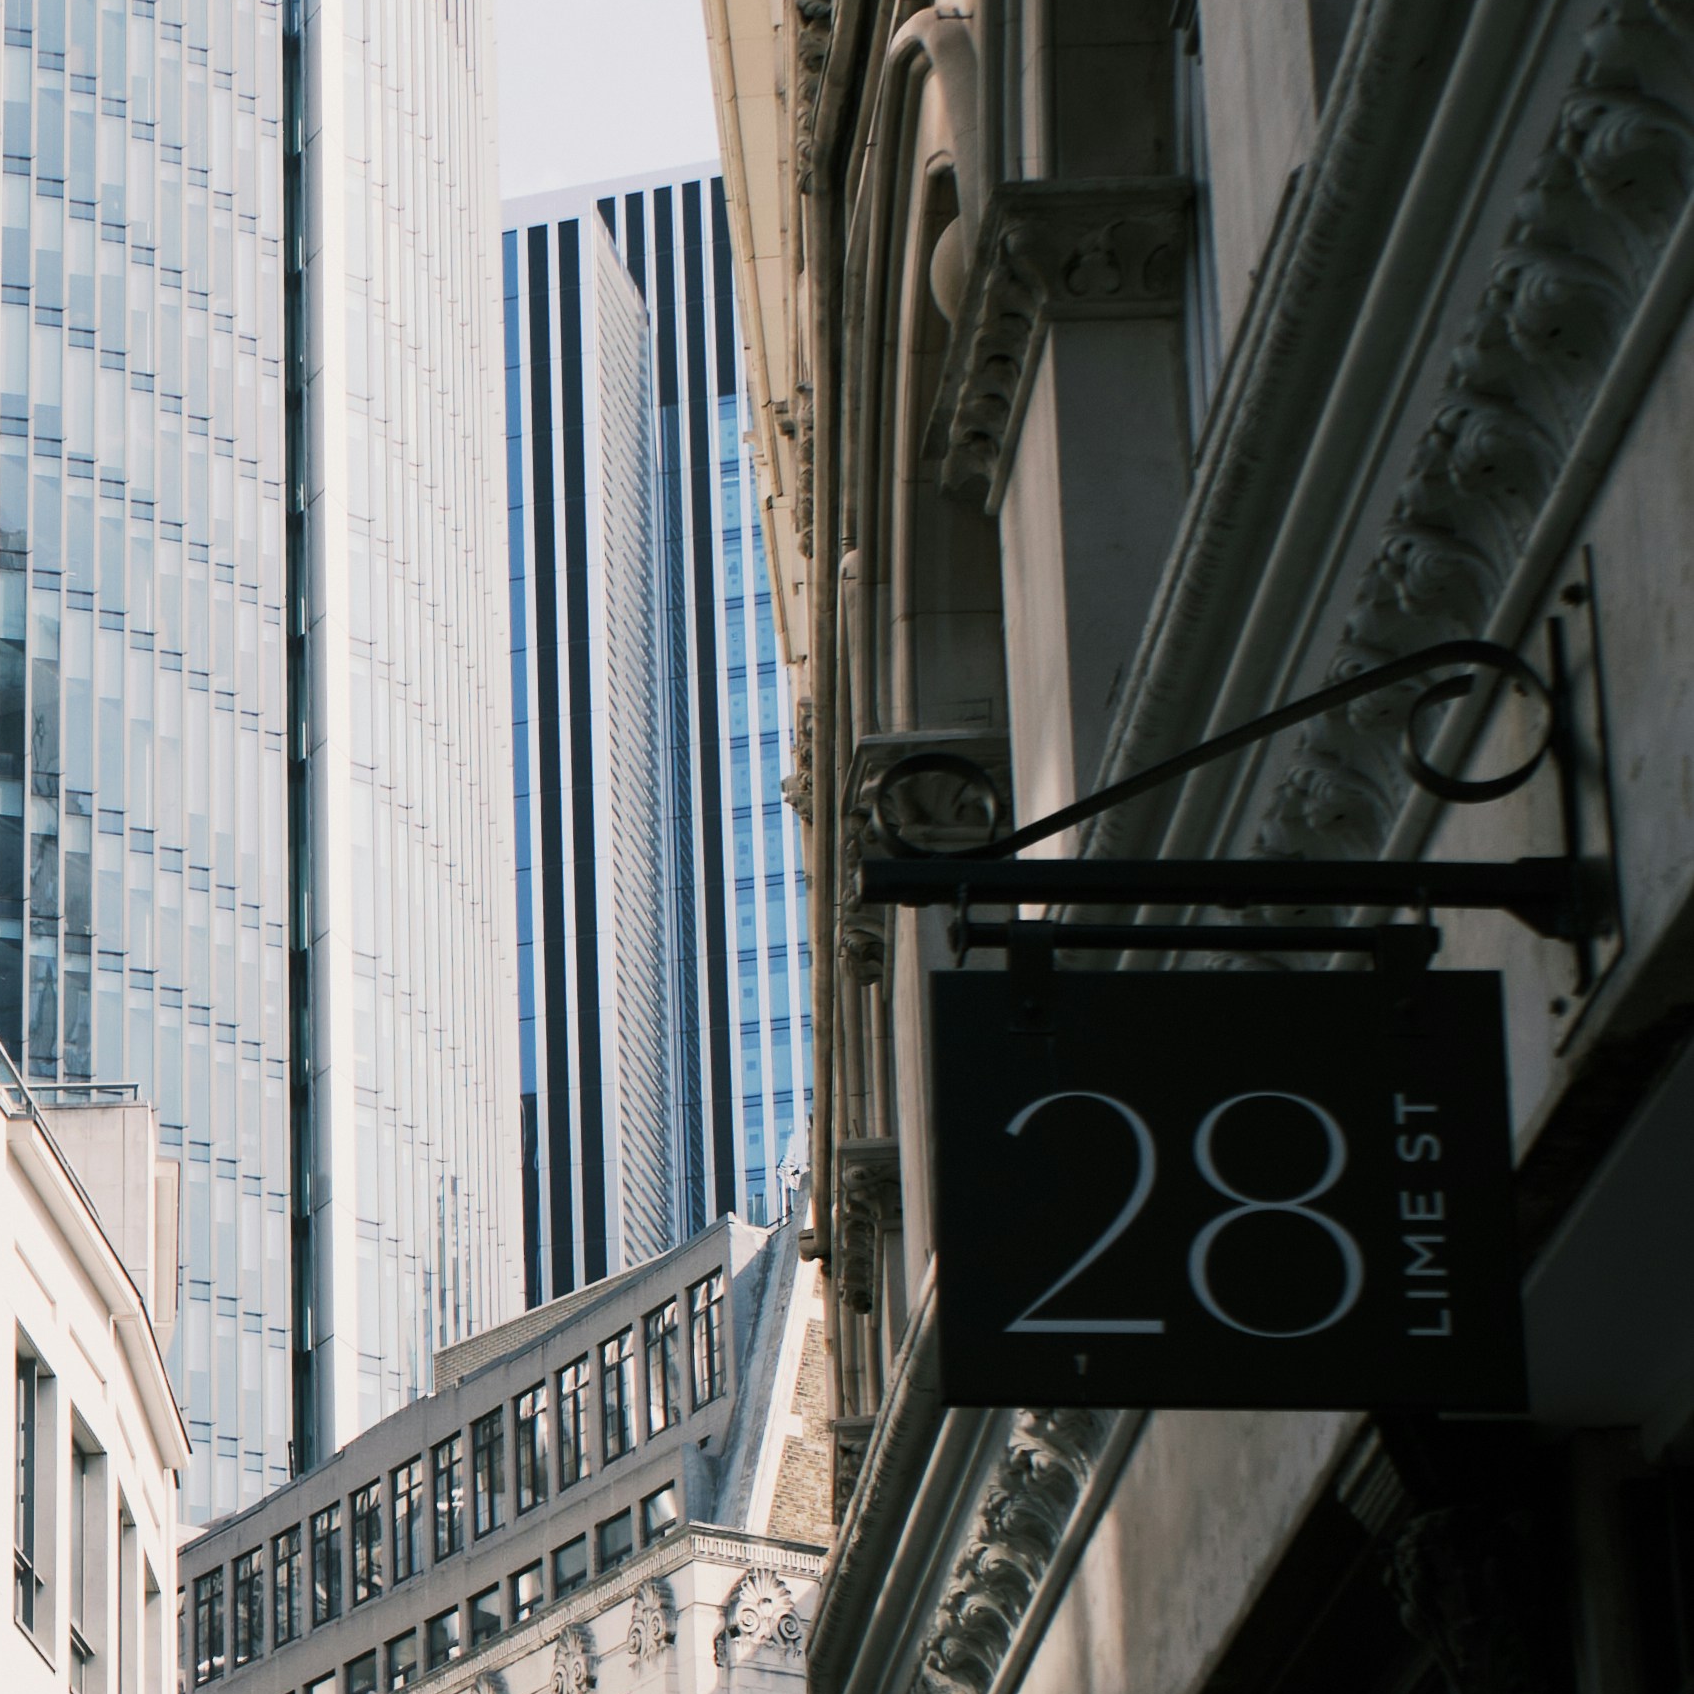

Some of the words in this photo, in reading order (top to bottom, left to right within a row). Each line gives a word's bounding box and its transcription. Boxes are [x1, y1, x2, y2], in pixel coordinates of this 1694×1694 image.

[1392, 1091, 1444, 1163] ST
[1002, 1089, 1367, 1340] 28
[1399, 1189, 1454, 1338] LIME
